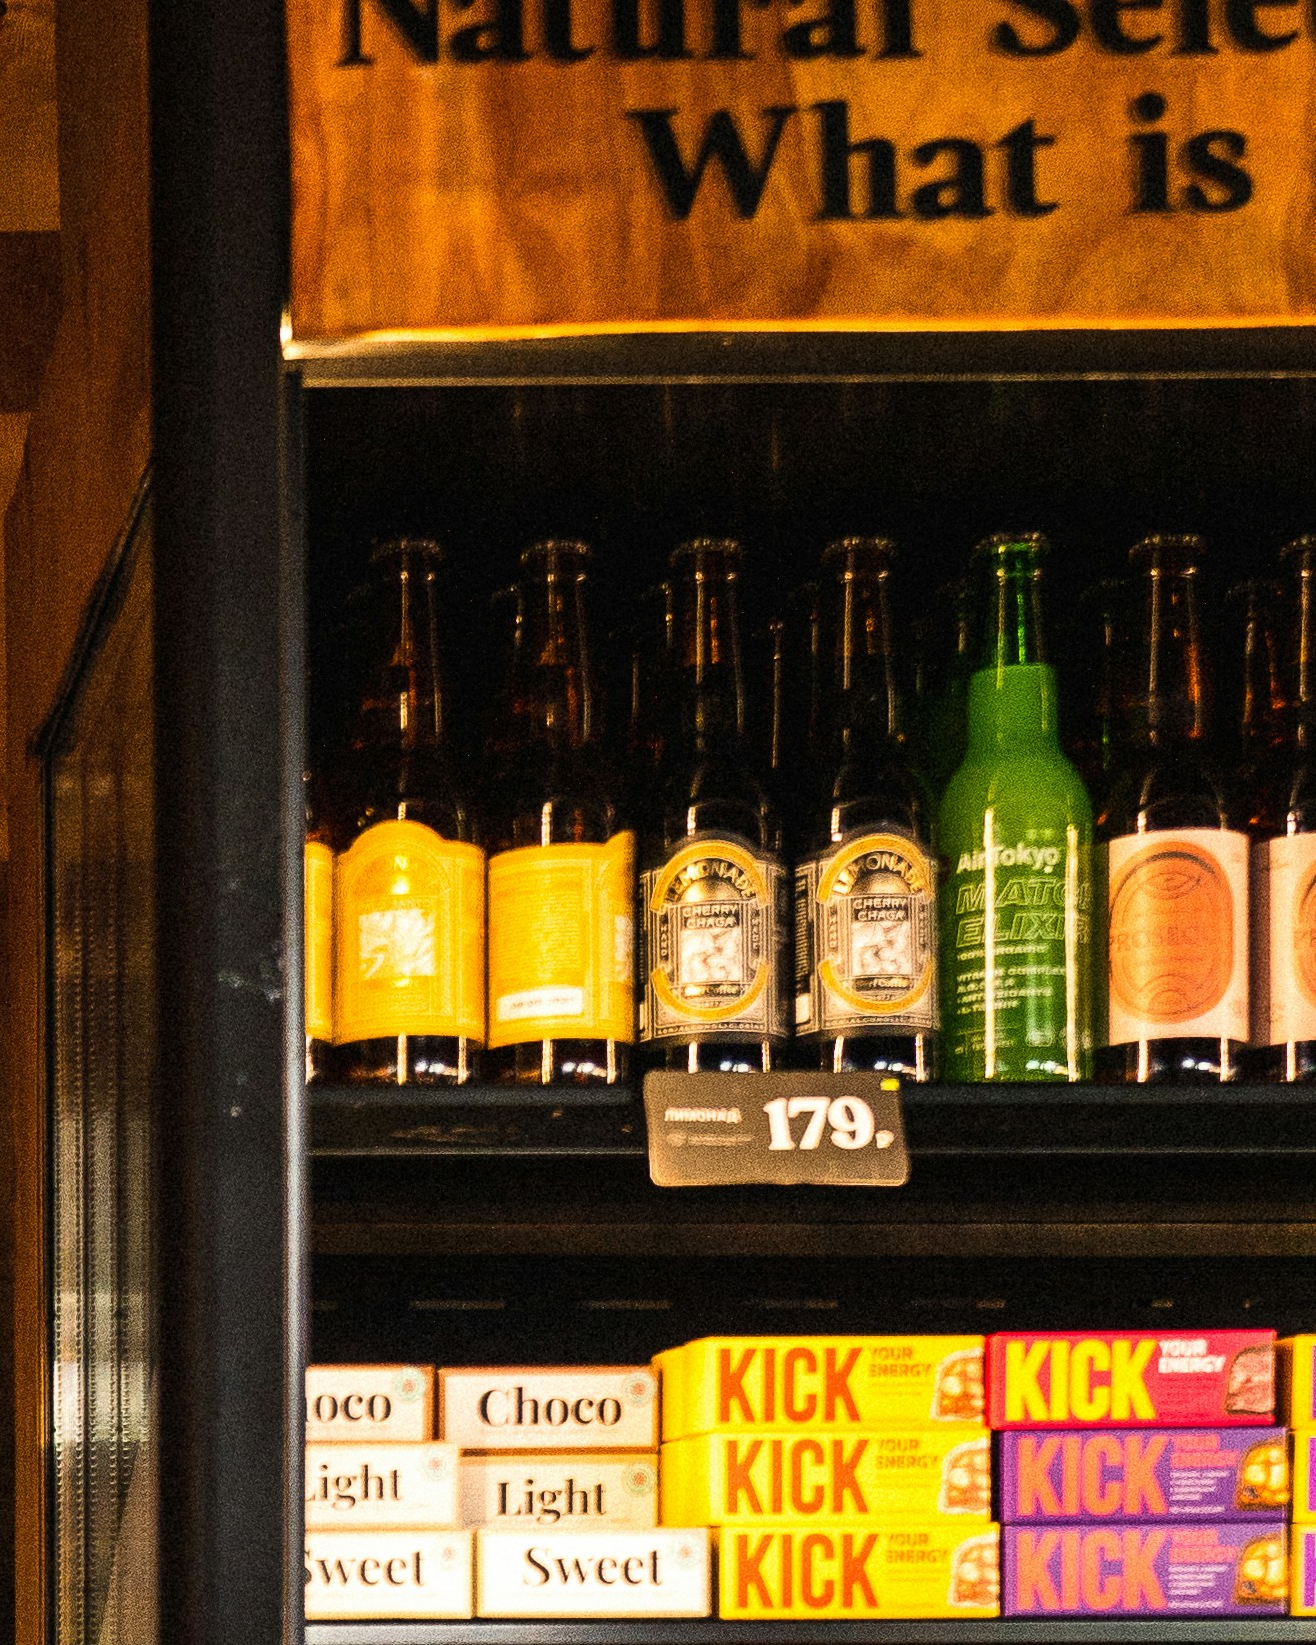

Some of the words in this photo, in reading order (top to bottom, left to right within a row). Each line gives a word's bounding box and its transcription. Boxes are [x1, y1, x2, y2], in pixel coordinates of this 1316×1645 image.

[337, 0, 921, 66] Natural
[990, 0, 1316, 60] Sele
[629, 99, 1060, 221] What
[1126, 91, 1255, 217] is
[666, 857, 757, 901] LEMONADE
[682, 904, 738, 916] CHERRY
[685, 916, 737, 929] CHAGA
[853, 898, 908, 910] CHERRY
[857, 910, 905, 922] CHAGA
[719, 1346, 863, 1424] KICK
[869, 1363, 932, 1378] ENERGY
[1005, 1338, 1162, 1422] KICK
[1157, 1356, 1227, 1374] ENERGY
[306, 1390, 392, 1424] oco
[478, 1386, 623, 1428] Choco
[726, 1438, 870, 1516] KICK
[876, 1455, 939, 1469] ENERGY
[1017, 1433, 1170, 1517] KICK
[496, 1477, 608, 1525] Light
[522, 1545, 663, 1588] Sweet
[736, 1532, 880, 1610] KICK
[885, 1549, 948, 1564] ENERGY
[1015, 1527, 1169, 1611] KICK
